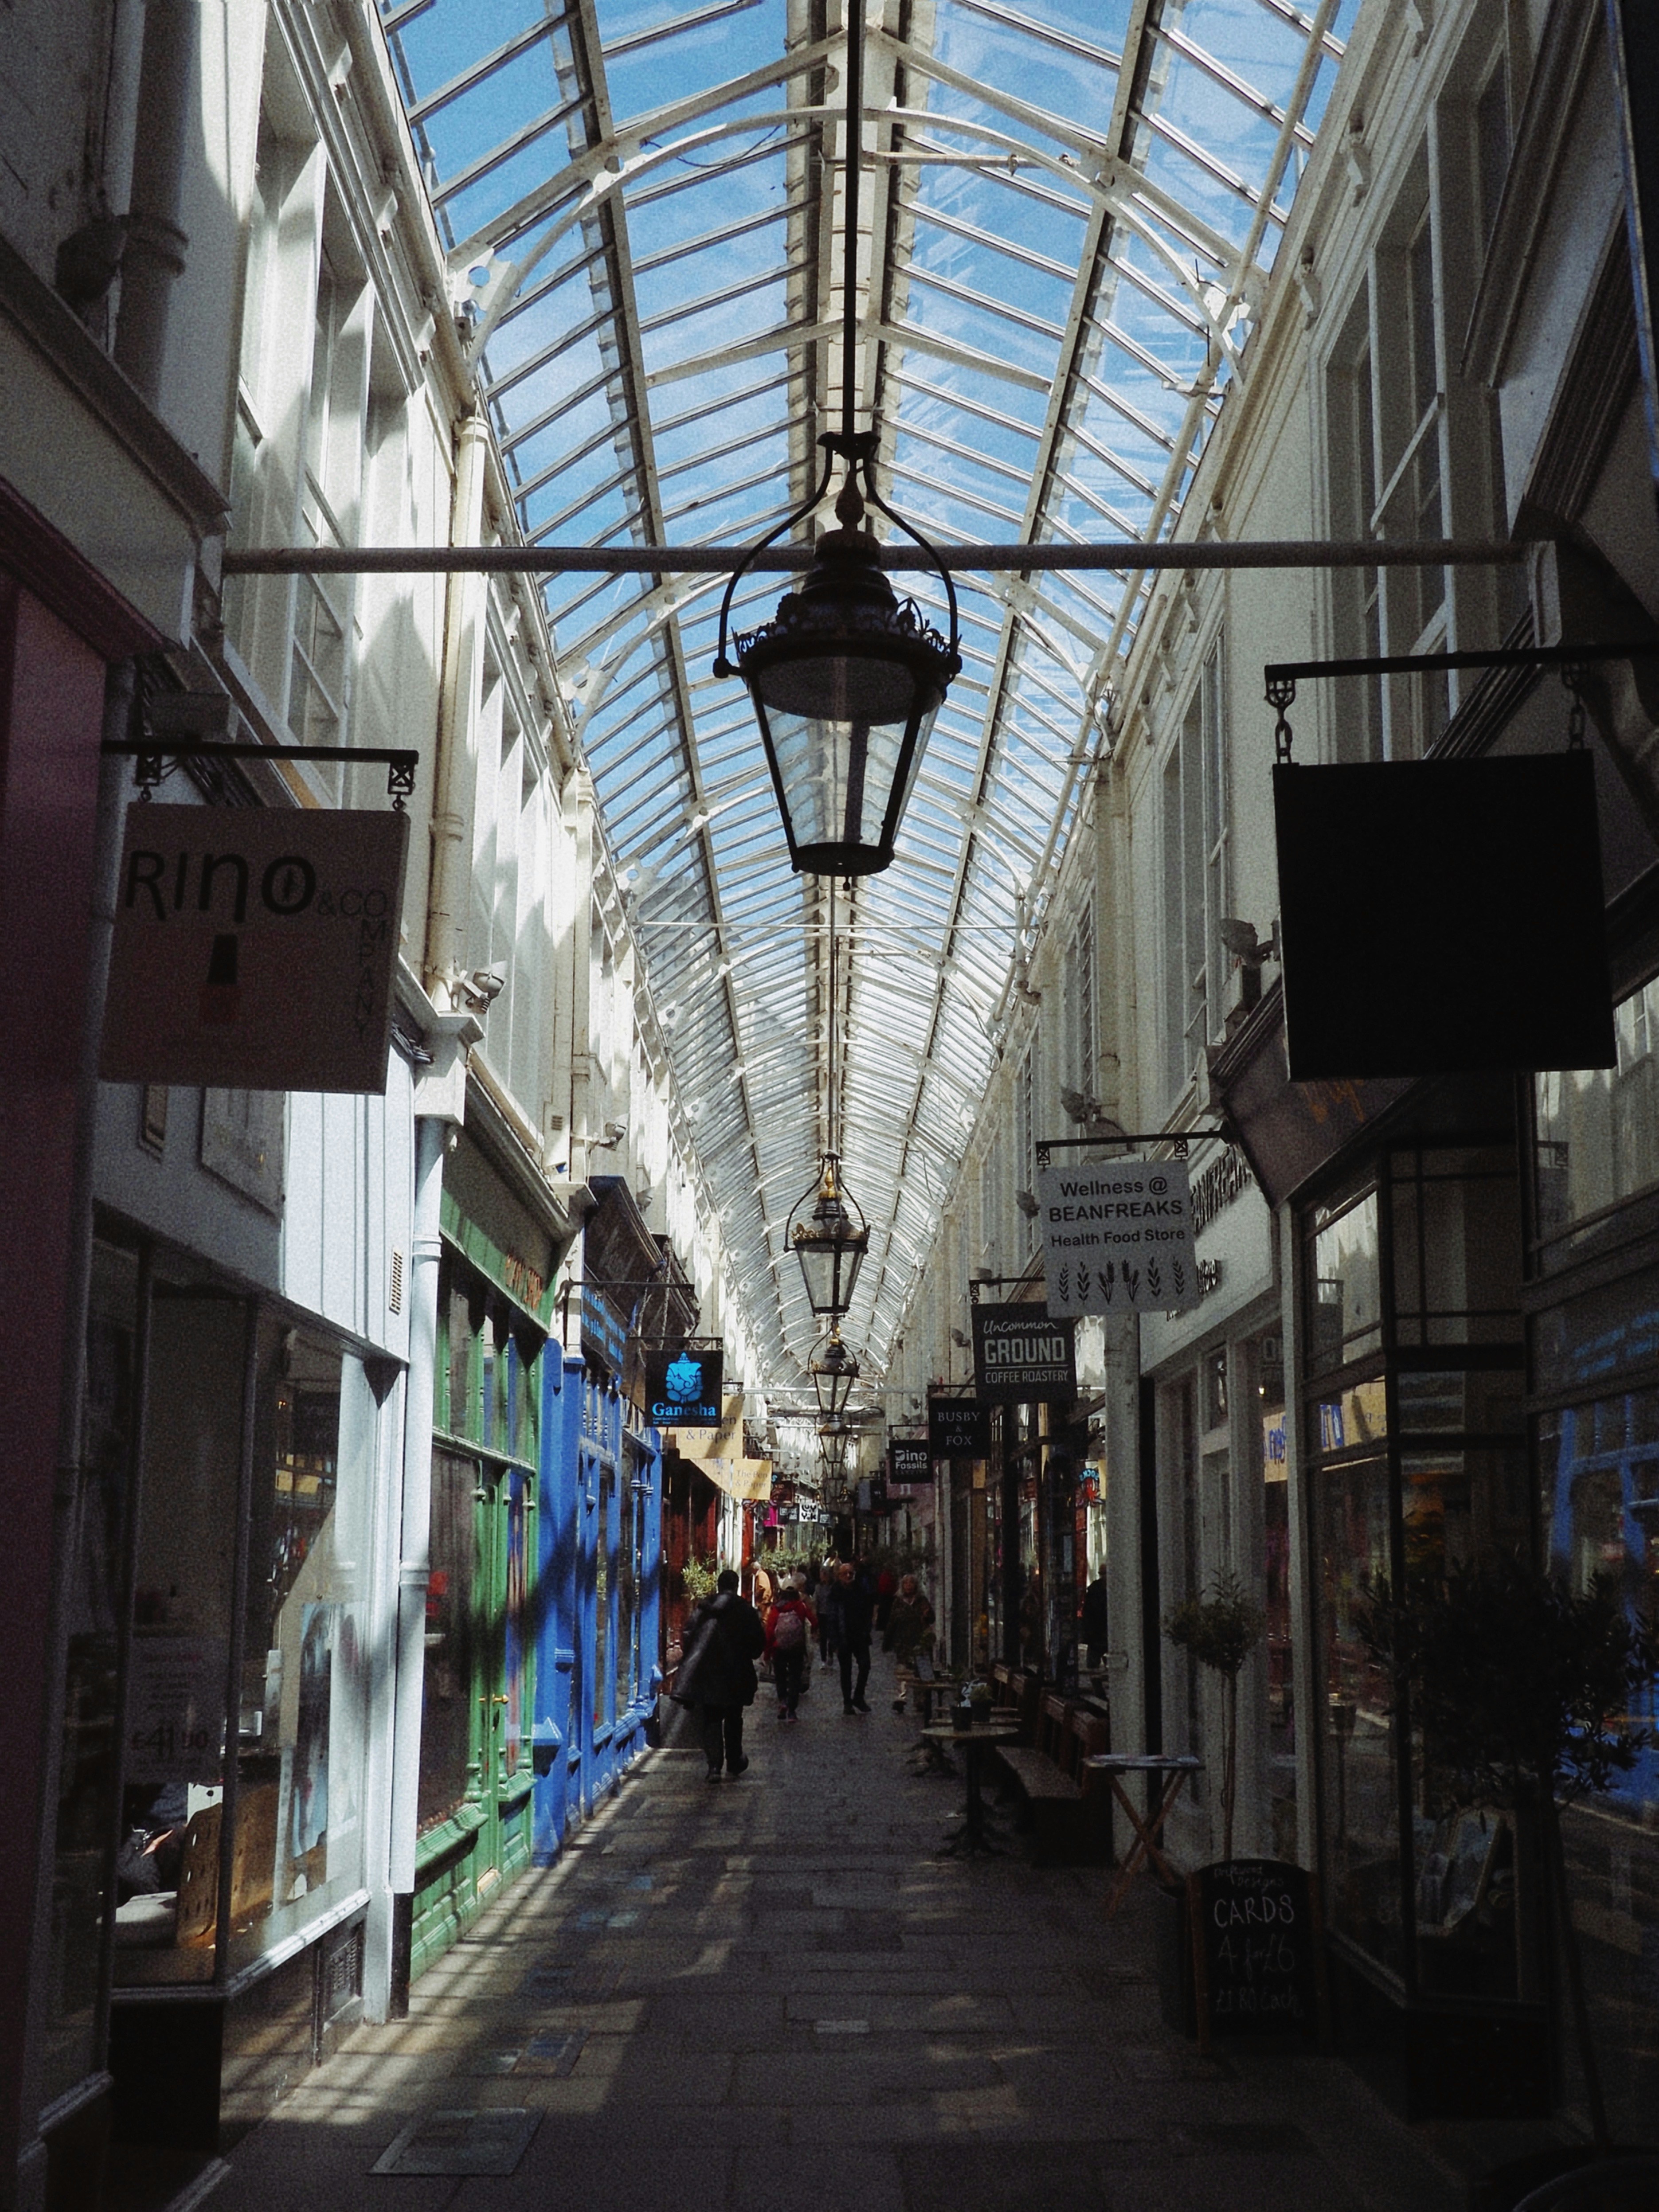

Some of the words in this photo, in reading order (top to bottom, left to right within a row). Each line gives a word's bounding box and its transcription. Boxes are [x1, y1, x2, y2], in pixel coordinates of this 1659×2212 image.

[1060, 1180, 1144, 1197] Wellness
[1149, 1176, 1168, 1195] @
[1049, 1200, 1183, 1222] BEANFREAKS
[1051, 1233, 1100, 1247] Health
[1104, 1230, 1140, 1244] Food
[1144, 1228, 1185, 1241] Store
[984, 1337, 1066, 1364] GROUND
[985, 1371, 1020, 1384] COFFEE
[1022, 1369, 1069, 1383] ROASTERY
[652, 1402, 716, 1416] Ganesha
[937, 1411, 980, 1422] BUSBY
[955, 1424, 962, 1433] &
[686, 1429, 695, 1440] &
[699, 1429, 736, 1443] Paper
[945, 1435, 972, 1446] FOX
[894, 1449, 928, 1462] Dino
[894, 1461, 928, 1470] Fossils
[1213, 1893, 1296, 1929] CARDS
